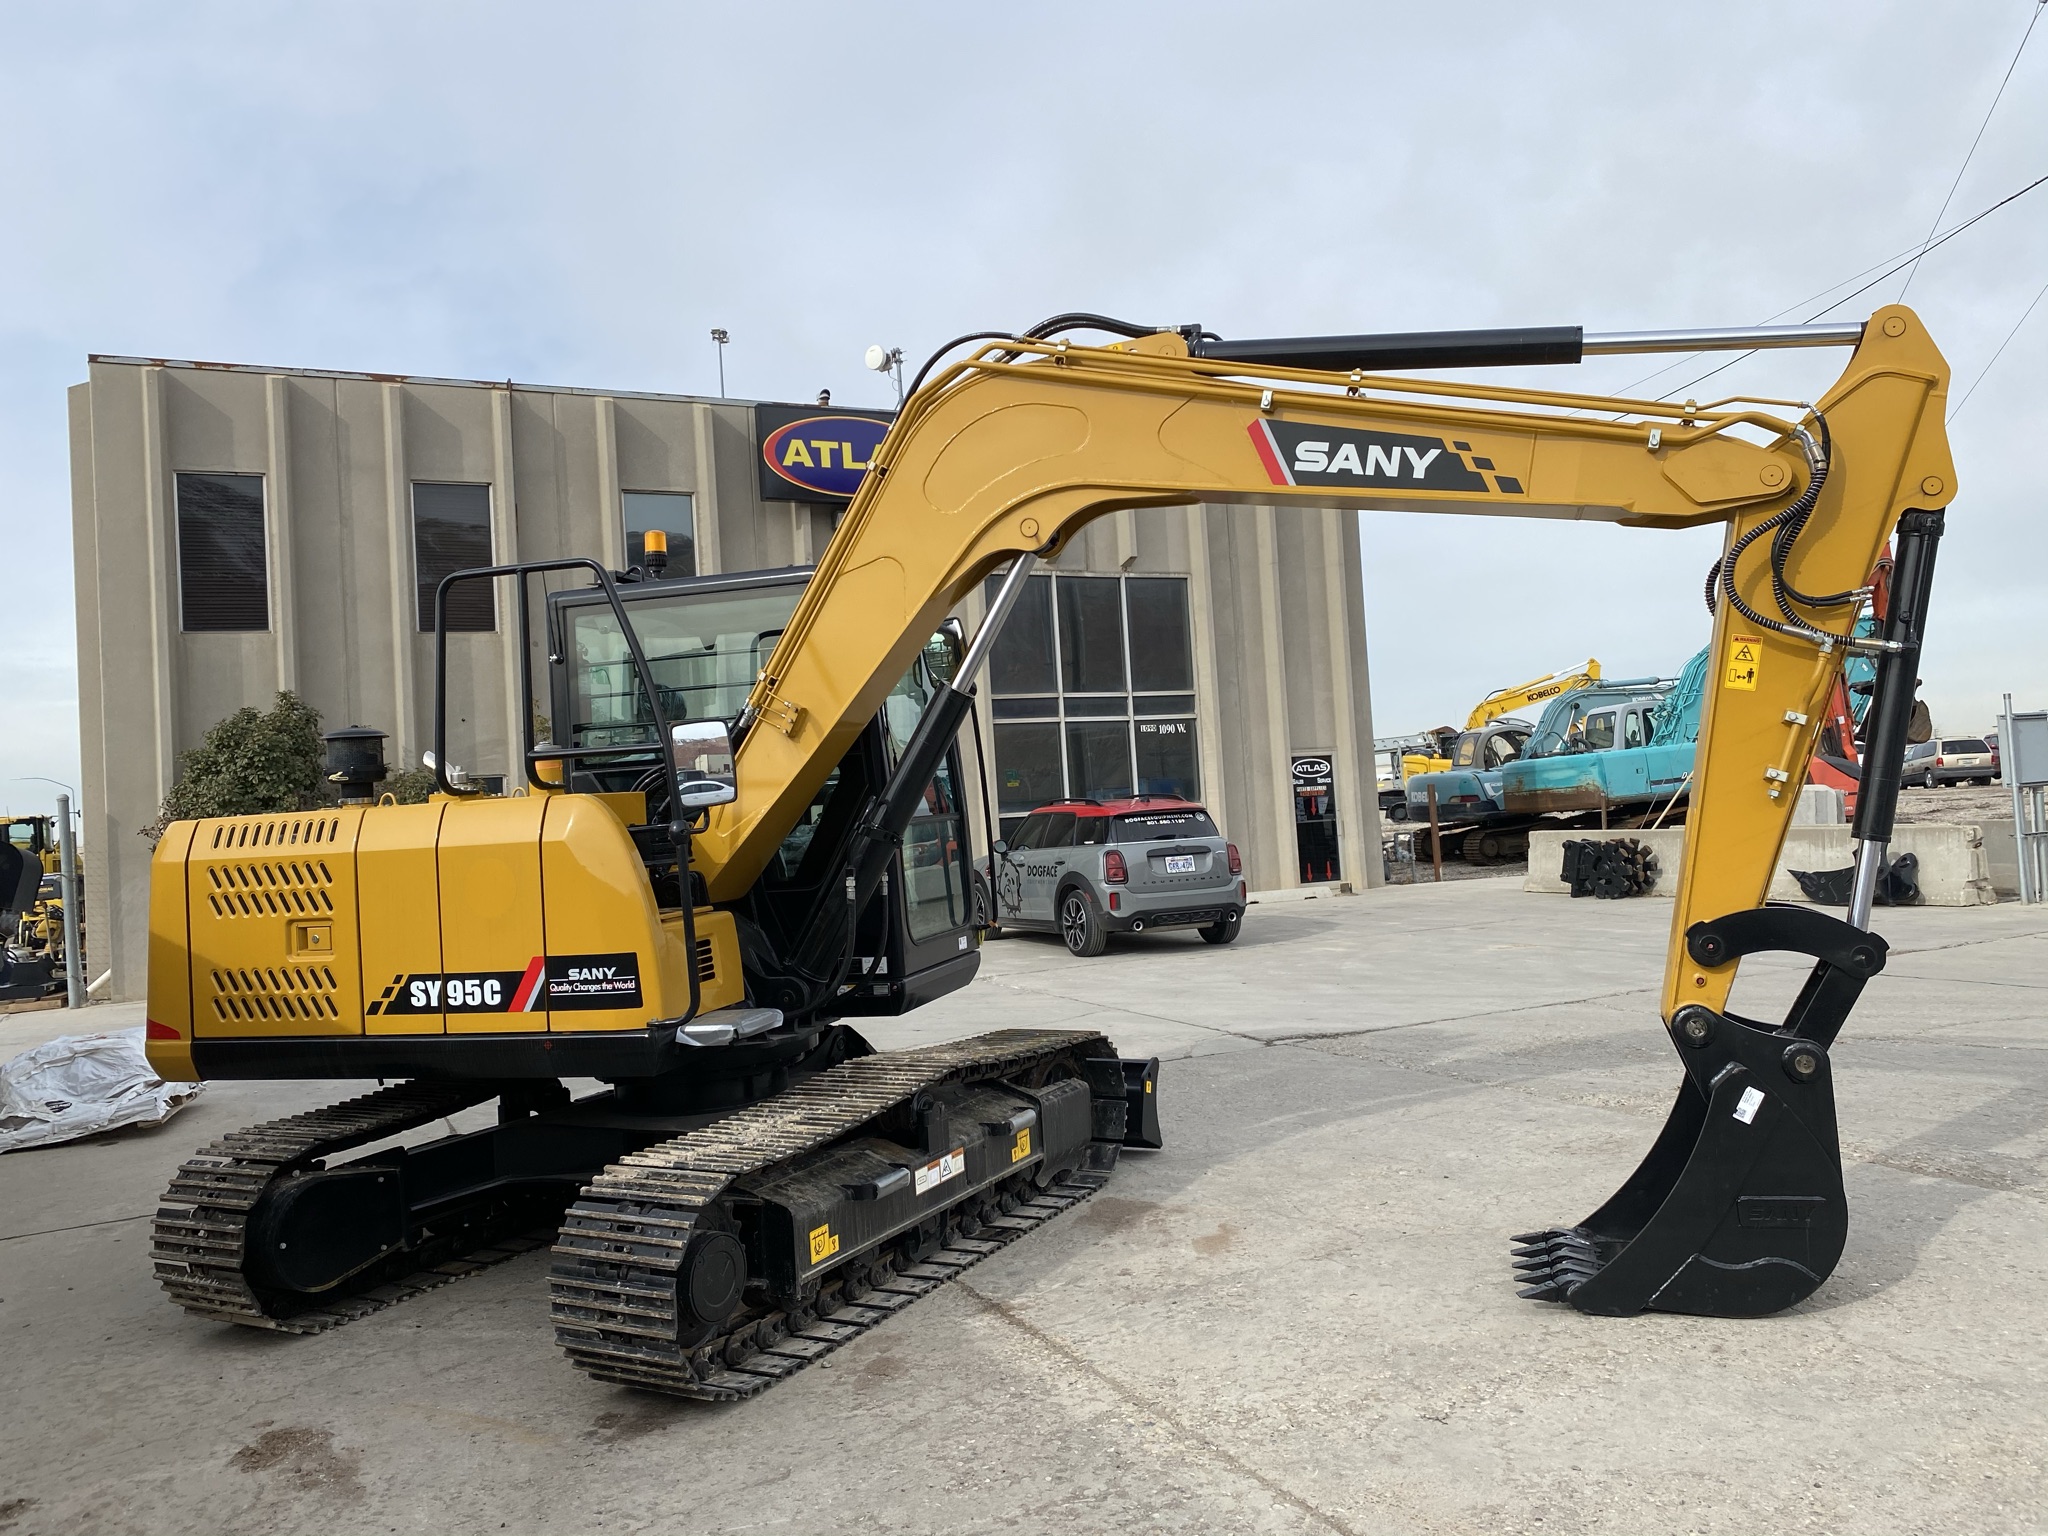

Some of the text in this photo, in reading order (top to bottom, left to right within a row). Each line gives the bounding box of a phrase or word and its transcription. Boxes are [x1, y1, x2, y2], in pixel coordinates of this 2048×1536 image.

[1293, 440, 1443, 479] SANY
[1526, 686, 1561, 702] KOBELCO
[1158, 723, 1175, 735] 1090
[1295, 763, 1327, 772] ATLAS
[1027, 864, 1058, 878] DOGFACE
[567, 966, 617, 981] SANY
[549, 980, 636, 994] Quality Changes the World
